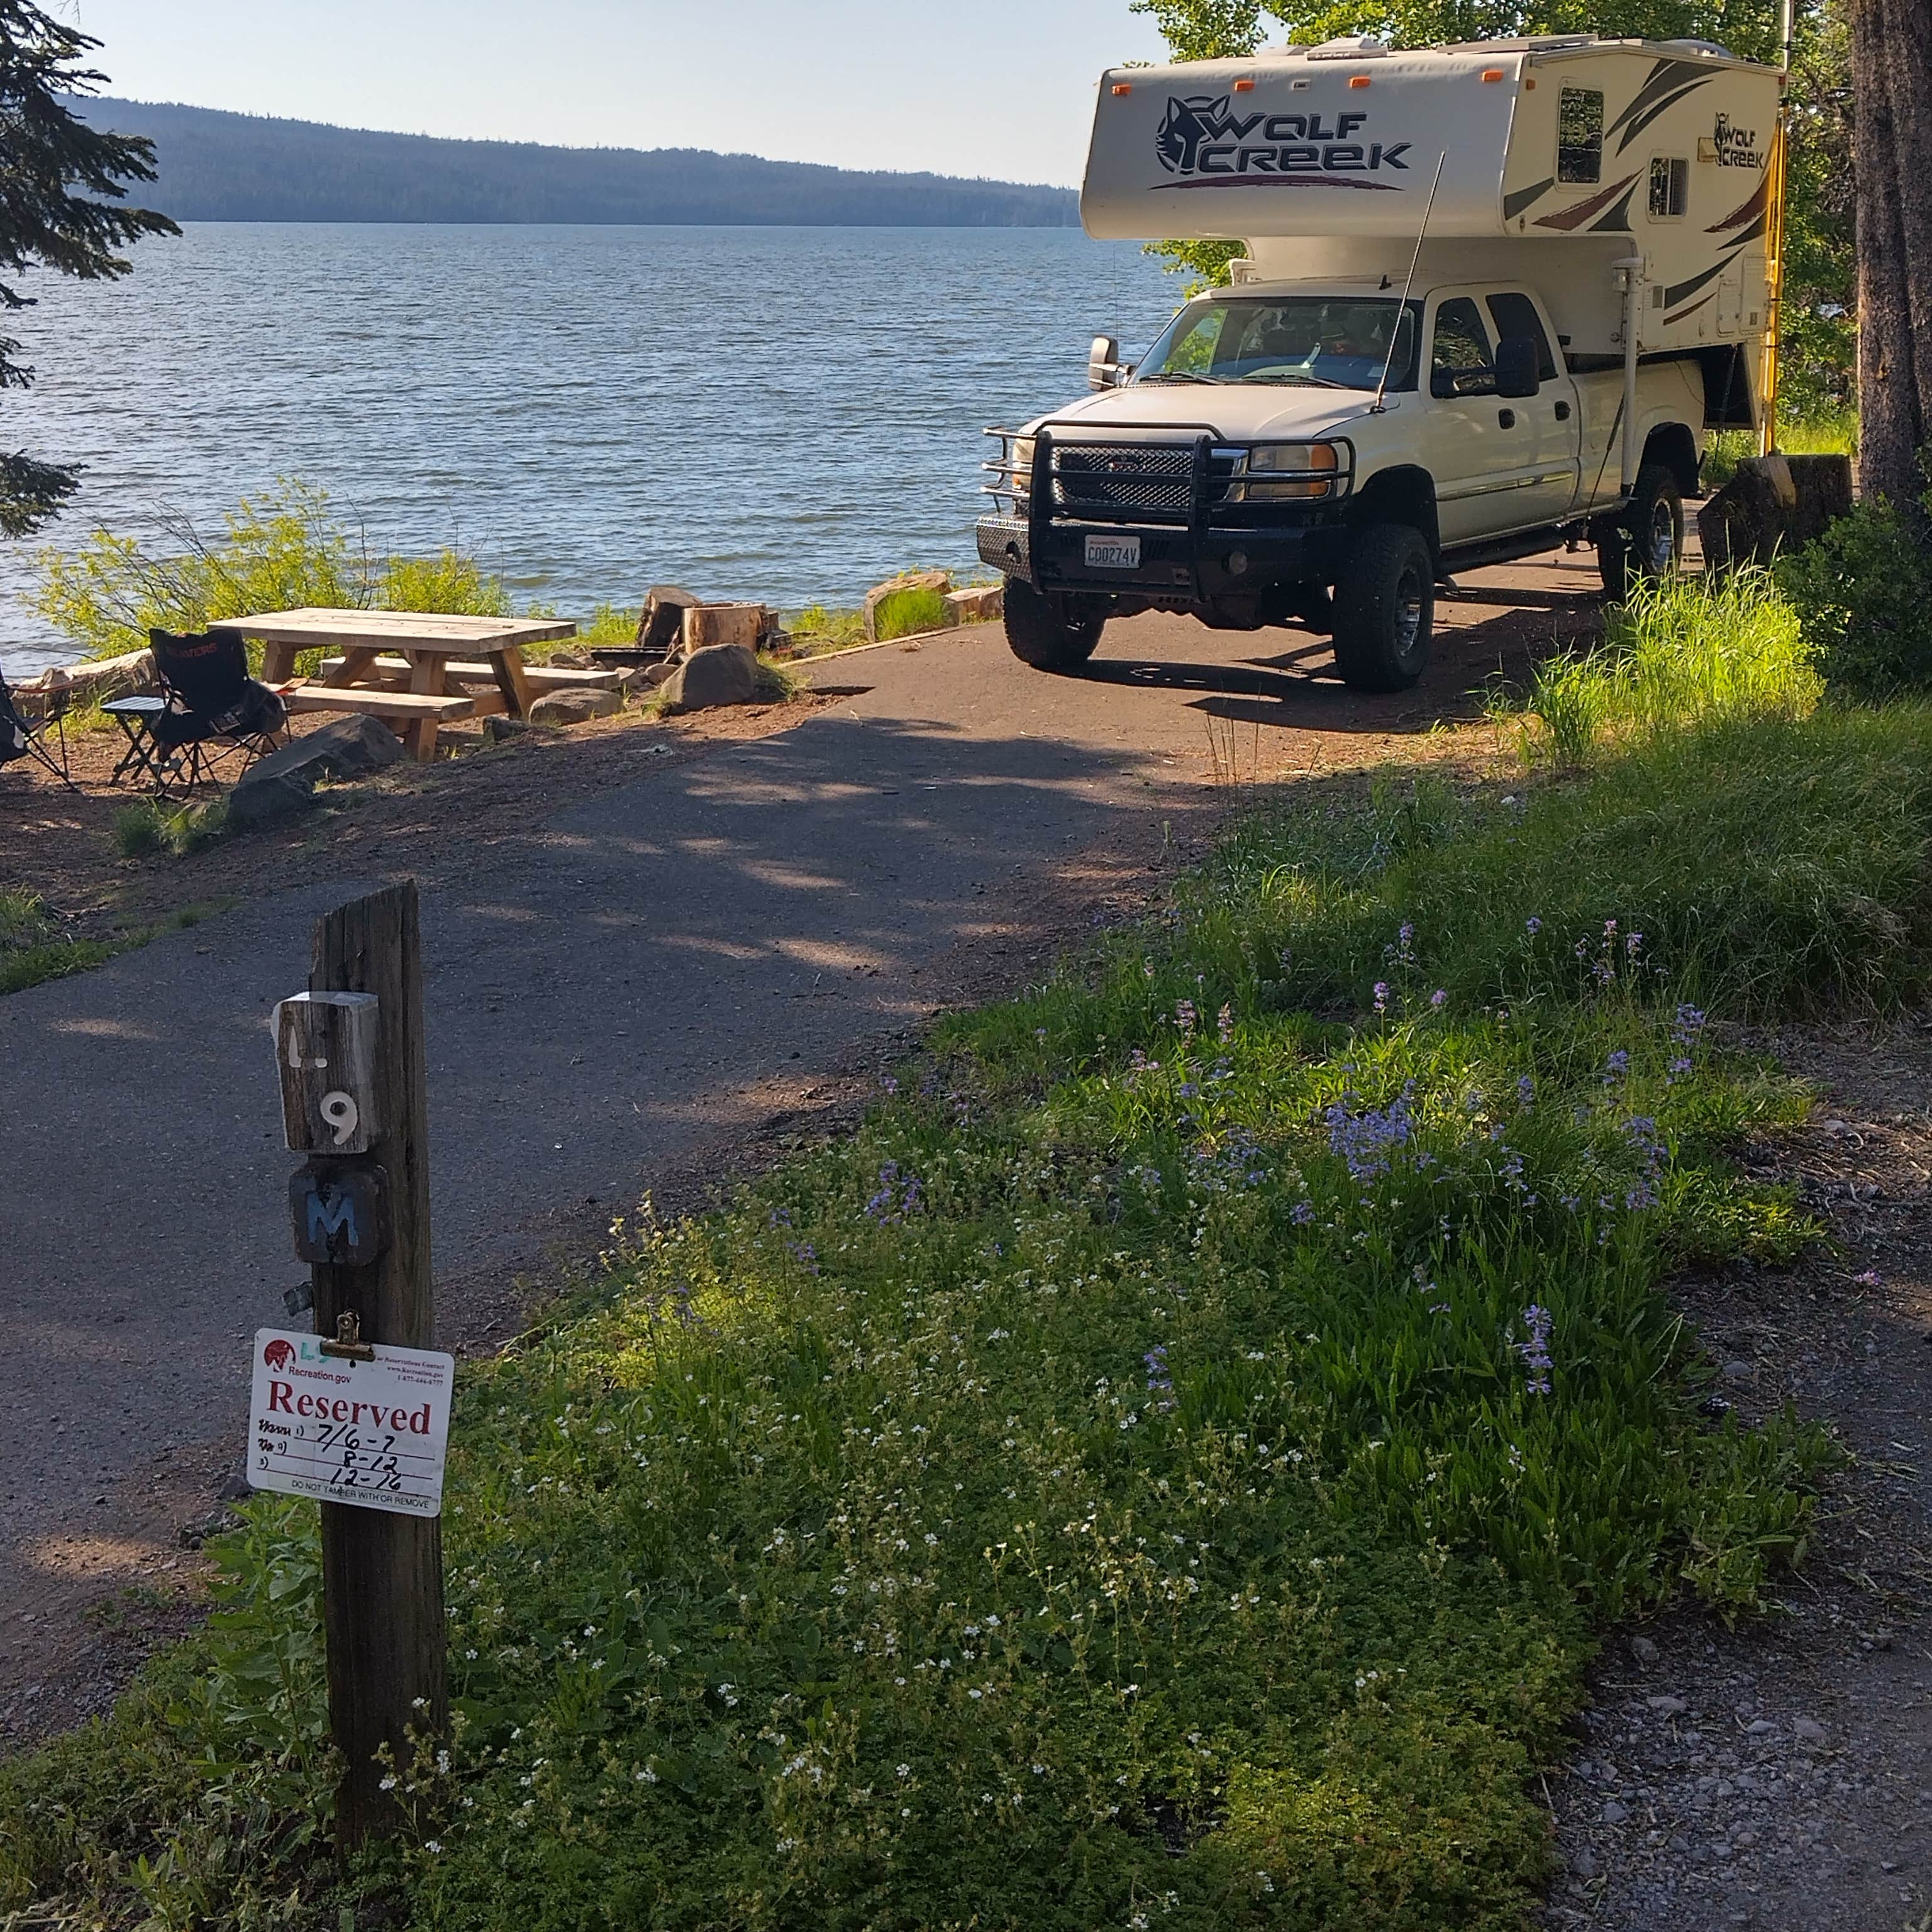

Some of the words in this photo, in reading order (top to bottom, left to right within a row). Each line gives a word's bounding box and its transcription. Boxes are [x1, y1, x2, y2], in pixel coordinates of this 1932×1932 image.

[1192, 112, 1367, 141] WOLF
[1723, 126, 1756, 147] WOLF
[320, 1091, 358, 1145] 9
[307, 1192, 359, 1246] M
[289, 1366, 352, 1384] Recreation.gov
[266, 1380, 431, 1435] Reserved
[291, 1480, 303, 1489] DO
[306, 1481, 321, 1492] NOT
[358, 1491, 378, 1501] WITH
[380, 1494, 393, 1503] OR
[395, 1496, 430, 1509] REMOVE
